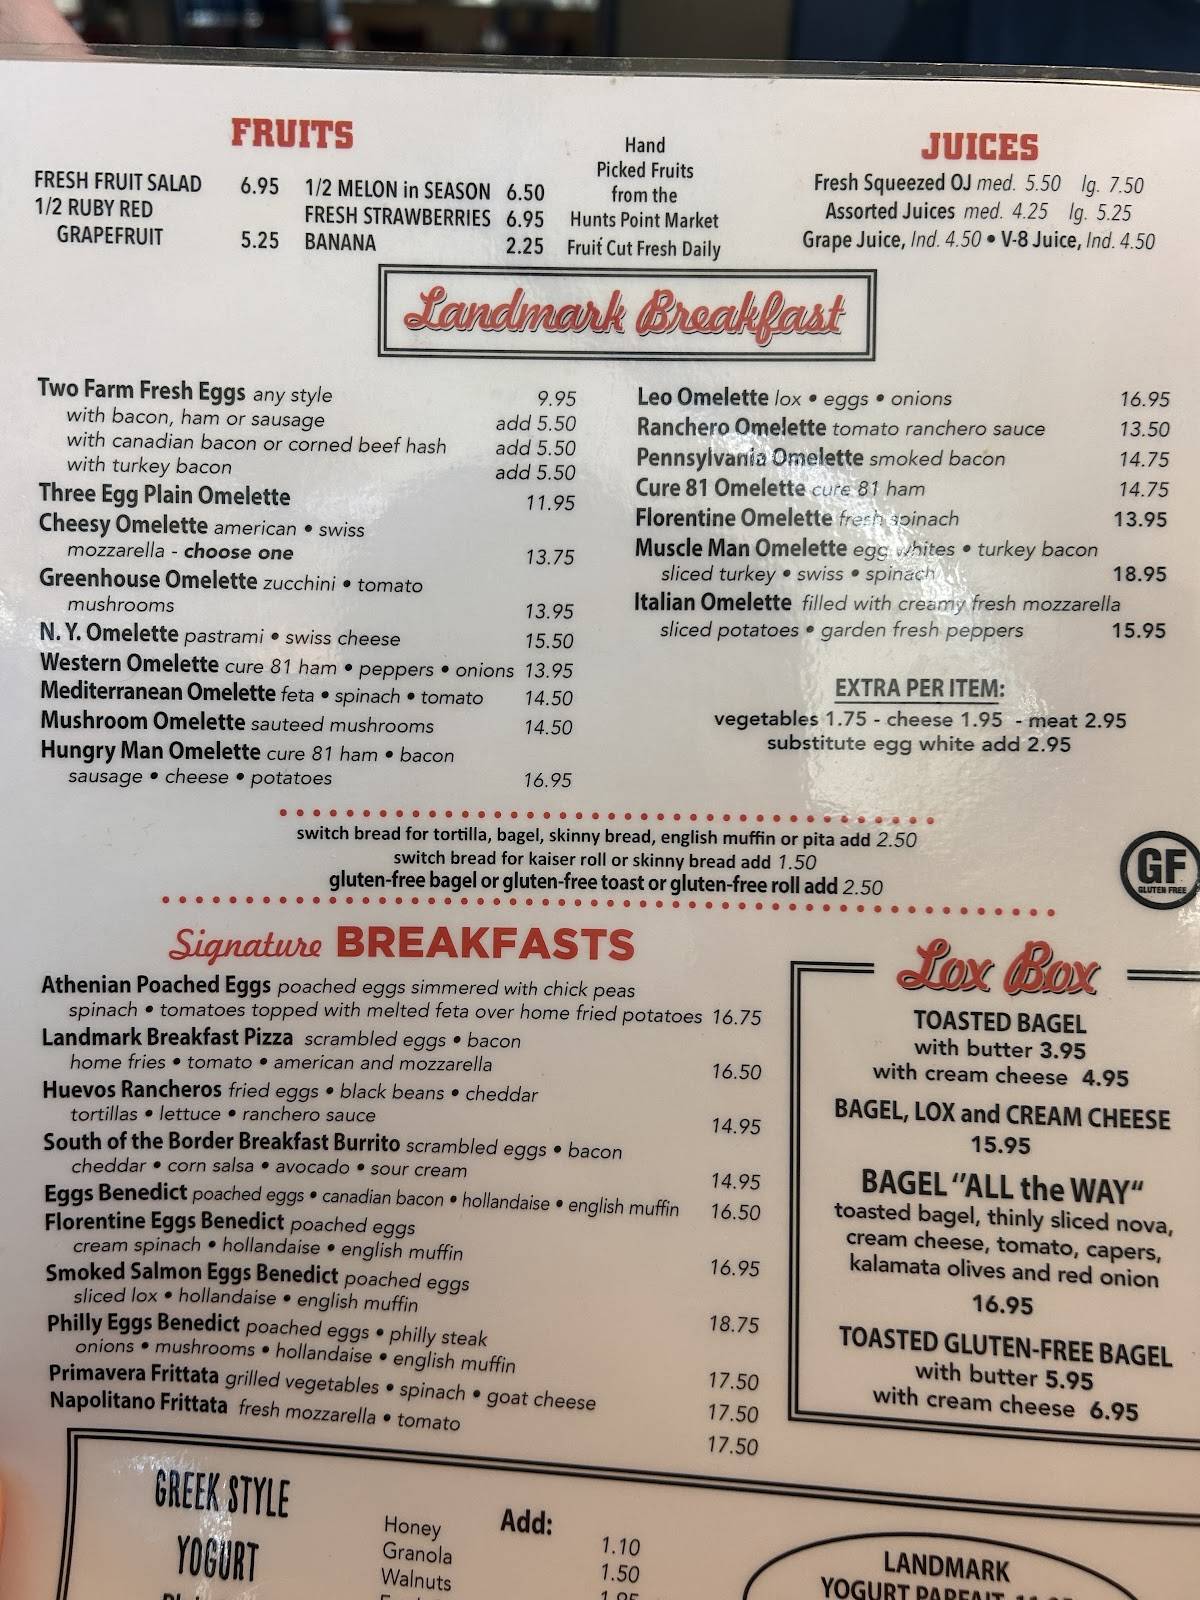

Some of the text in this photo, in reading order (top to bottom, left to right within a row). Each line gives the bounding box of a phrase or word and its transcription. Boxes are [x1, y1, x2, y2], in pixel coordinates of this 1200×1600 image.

[231, 117, 354, 150] FRUITS
[625, 136, 666, 154] Hand
[920, 131, 1039, 161] JUICES
[597, 160, 694, 179] Picked Fruits
[34, 170, 279, 196] FRESH FRUIT SALAD 6.95
[305, 177, 545, 202] 1/2 MELON in SEASON 6.50
[611, 184, 678, 204] from the
[813, 172, 1146, 198] Fresh Squeezed OJ med. 5.50 lg. 7.50
[35, 196, 154, 218] 1/2 RUBY RED
[305, 205, 544, 229] FRESH STRAWBERRIES 6.95
[570, 210, 719, 229] Hunts Point Market
[824, 200, 1134, 227] Assorted Juices med. 4.25 lg. 5.25
[56, 224, 279, 250] GRAPEFRUIT 5.25
[305, 232, 544, 255] BANANA 2.25
[402, 284, 848, 348] Landmark Breakfast
[37, 376, 577, 408] Two Farm Fresh Eggs any style 9.95
[638, 386, 1171, 411] Leo Omelette lox eggs onions 16.95
[637, 416, 1171, 438] Ranchero Omelette tomato ranchero sauce 13.50
[67, 455, 576, 481] with turkey bacon add 5.50
[38, 481, 576, 511] Three Egg Plain Omelette 11.95
[835, 677, 1005, 698] EXTRA PER ITEM:
[40, 709, 573, 736] Mushroom Omelette sauteed mushrooms 14.50
[767, 733, 1072, 756] substitute egg white add 2.95
[393, 849, 817, 872] switch bread for kaiser roll or skinny bread add 1.50
[1137, 847, 1187, 885] GF
[1138, 886, 1187, 894] GLUTEN FREE
[167, 924, 637, 966] Signature BREAKFASTS
[895, 936, 1103, 996] Lox Box
[40, 974, 636, 1002] Athenian Poached Eggs poached eggs simmered with chick peas
[913, 1009, 1088, 1035] TOASTED BAGEL
[42, 1026, 521, 1052] Landmark Breakfast Pizza scrambled eggs bacon
[913, 1037, 1086, 1060] with butter 3.95
[834, 1097, 1172, 1131] BAGEL, LOX and CREAM CHEESE
[971, 1135, 1031, 1155] 15.95
[45, 1260, 470, 1296] Smoked Salmon Eggs Benedict poached eggs
[710, 1314, 760, 1335] 18.75
[838, 1325, 1174, 1368] TOASTED GLUTEN-FREE BAGEL
[50, 1389, 461, 1432] Napolitano Frittata fresh mozzarella tomato
[708, 1435, 759, 1457] 17.50
[154, 1468, 291, 1519] GREEK STYLE
[384, 1515, 442, 1542] Honey
[500, 1508, 553, 1536] Add:
[177, 1534, 260, 1583] YOGURT
[382, 1540, 453, 1565] Granola
[602, 1536, 641, 1557] 1.10
[381, 1567, 452, 1592] Walnuts
[601, 1562, 640, 1584] 1.50
[884, 1550, 1011, 1584] LANDMARK
